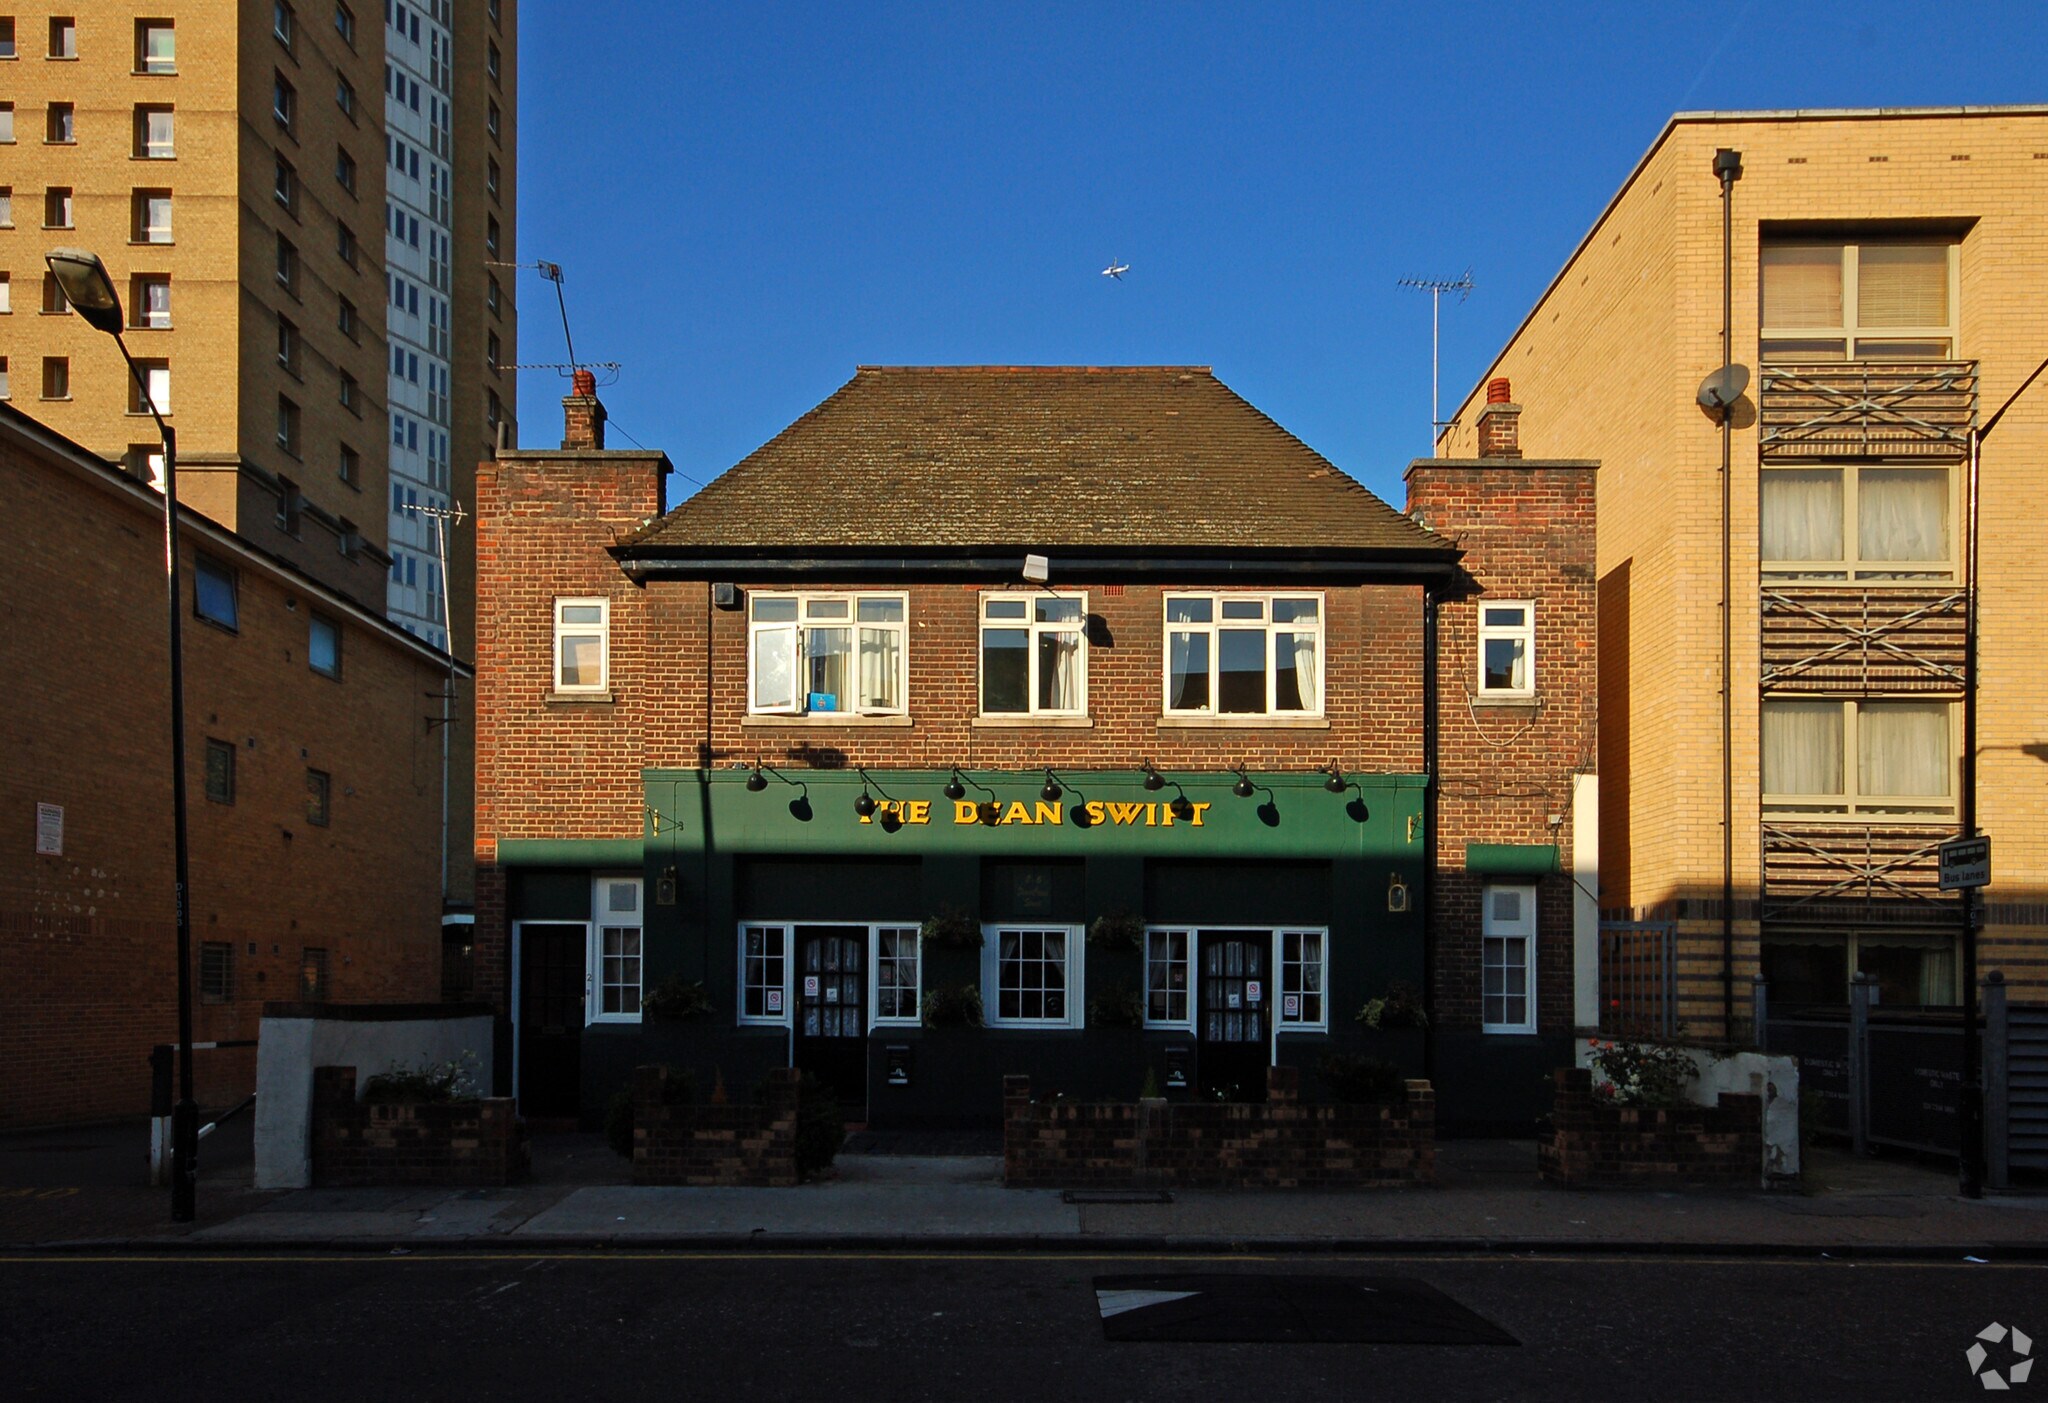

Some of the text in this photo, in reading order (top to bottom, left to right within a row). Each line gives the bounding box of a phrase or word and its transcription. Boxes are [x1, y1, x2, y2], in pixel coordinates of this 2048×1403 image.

[953, 800, 1064, 825] DEAN
[1085, 800, 1211, 827] SWIFT
[1944, 871, 1985, 883] Bus lanes
